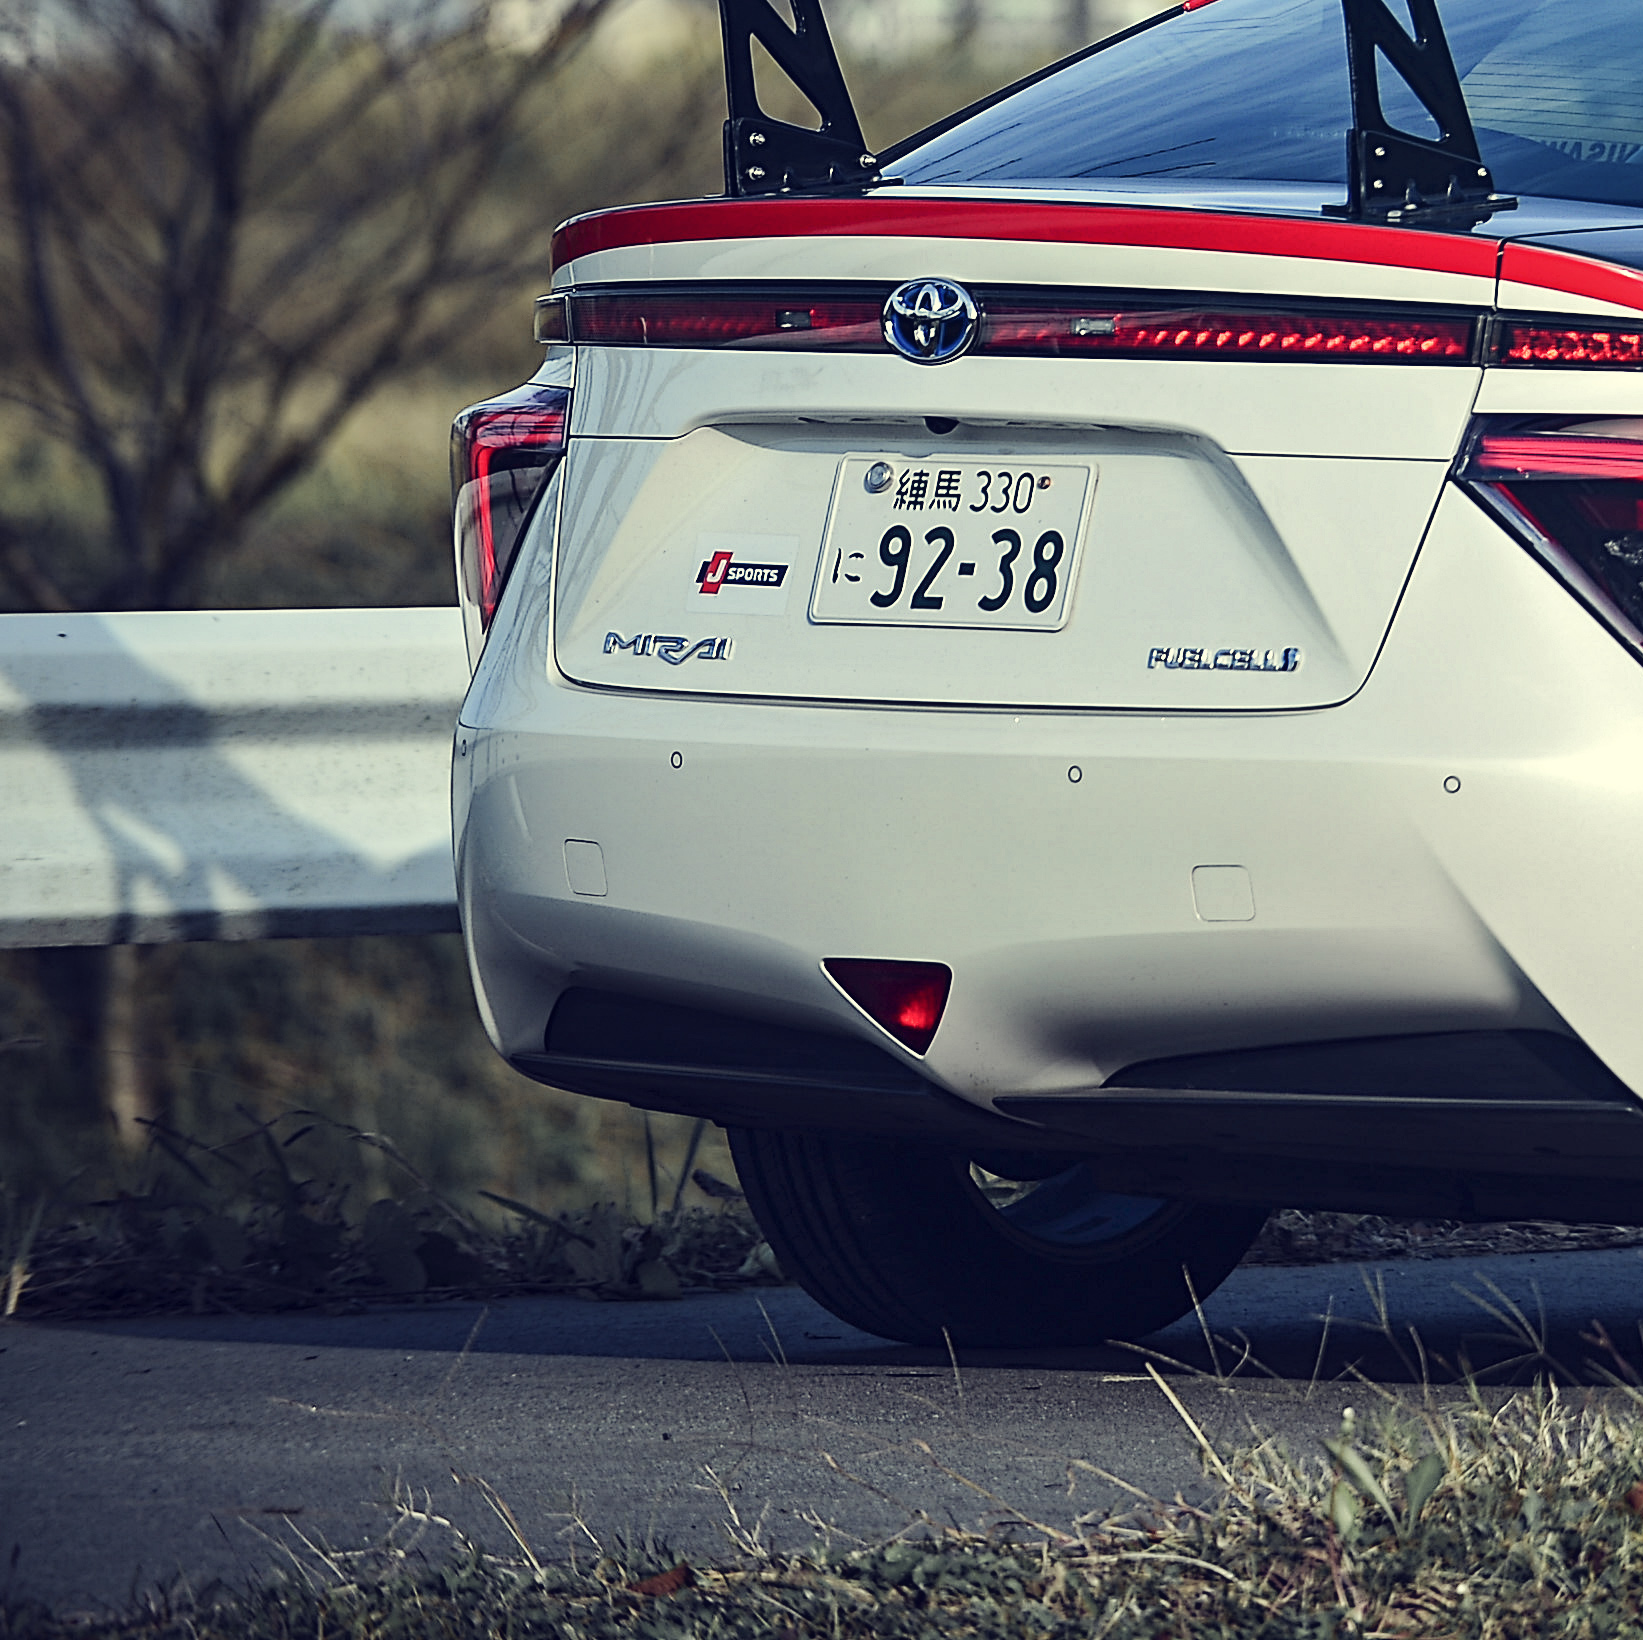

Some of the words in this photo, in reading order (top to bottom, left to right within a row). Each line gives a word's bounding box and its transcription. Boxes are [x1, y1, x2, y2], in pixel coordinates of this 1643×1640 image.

[893, 468, 963, 513] 練馬
[969, 470, 1035, 514] 330
[727, 566, 780, 582] SPORTS
[832, 547, 866, 584] に
[869, 525, 1065, 613] 92-38
